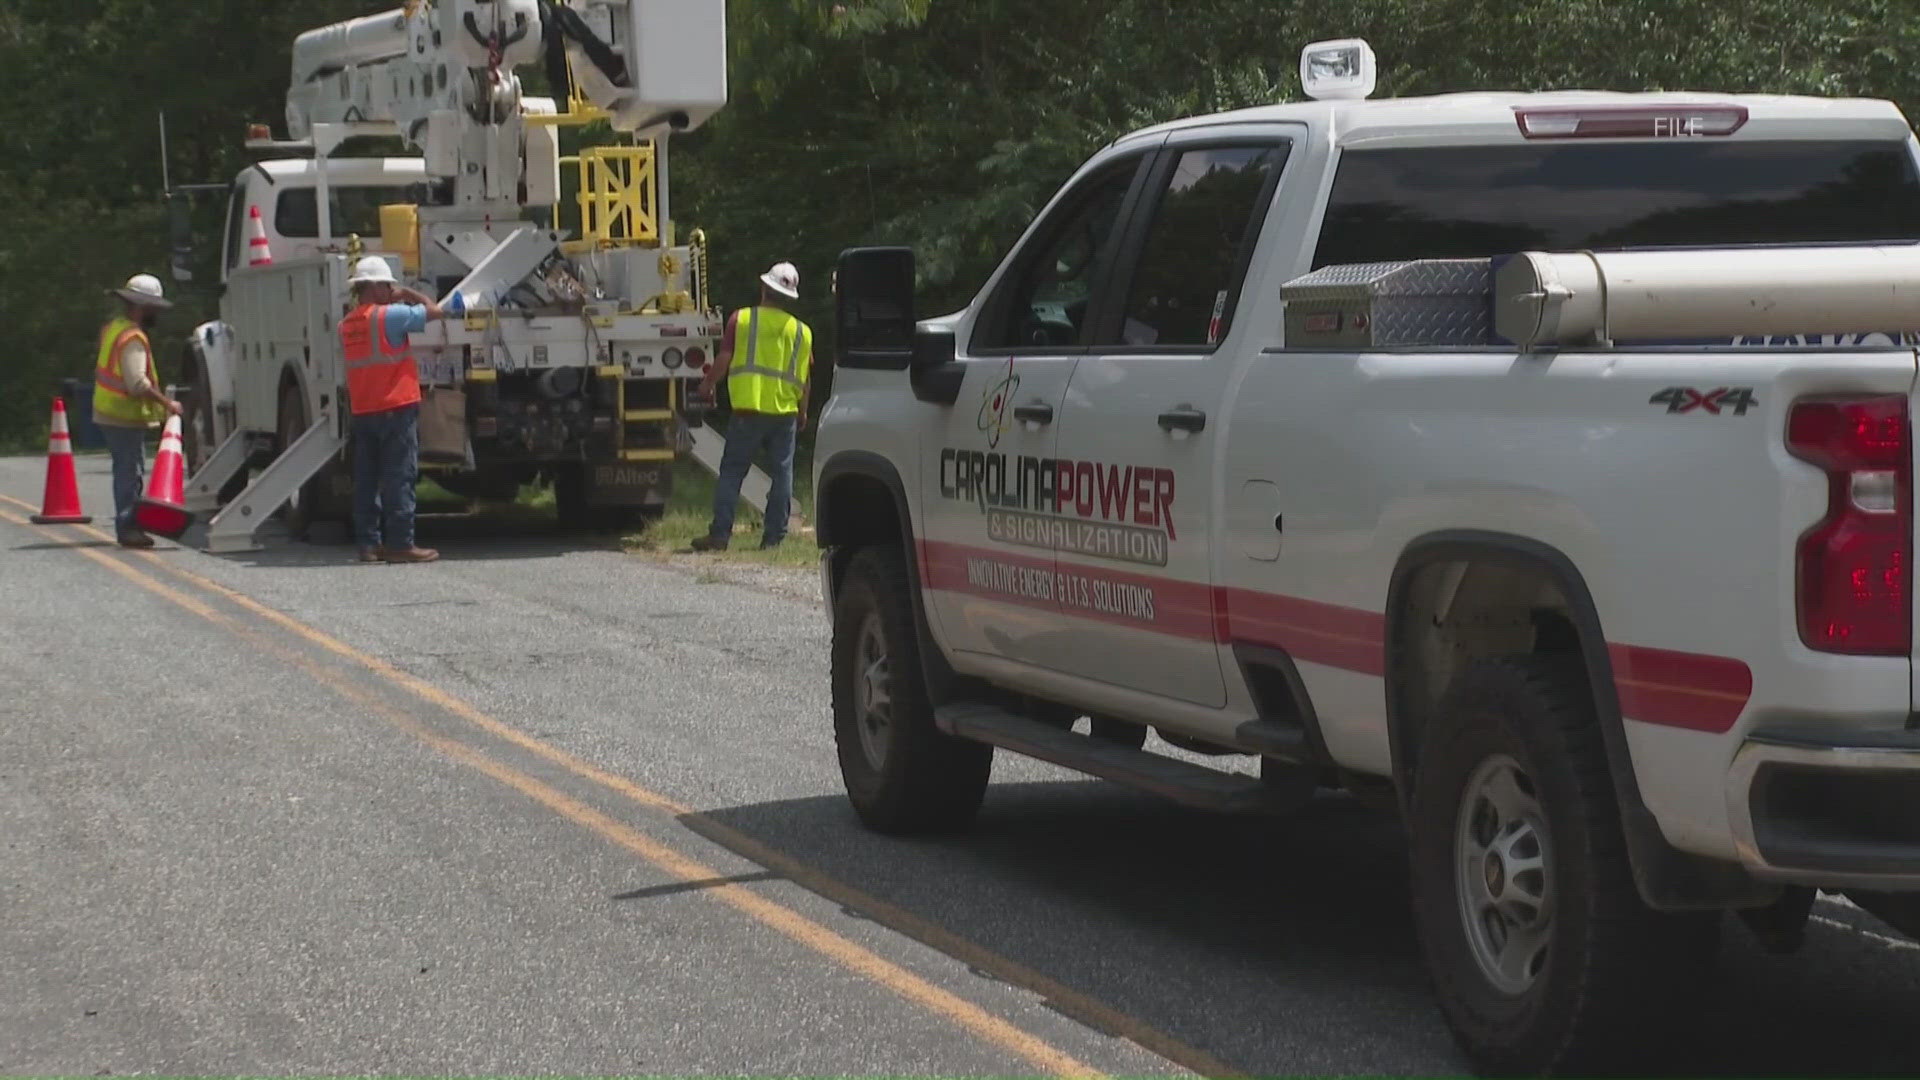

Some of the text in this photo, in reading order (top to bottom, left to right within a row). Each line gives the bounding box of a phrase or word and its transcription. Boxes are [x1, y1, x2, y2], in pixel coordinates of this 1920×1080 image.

[991, 512, 1164, 562] & SIGNALIZATION
[967, 557, 1018, 594] INNOVATIVE
[1018, 567, 1054, 601] ENERGY
[1057, 573, 1067, 603] &
[1094, 579, 1155, 620] SOLUTIONS
